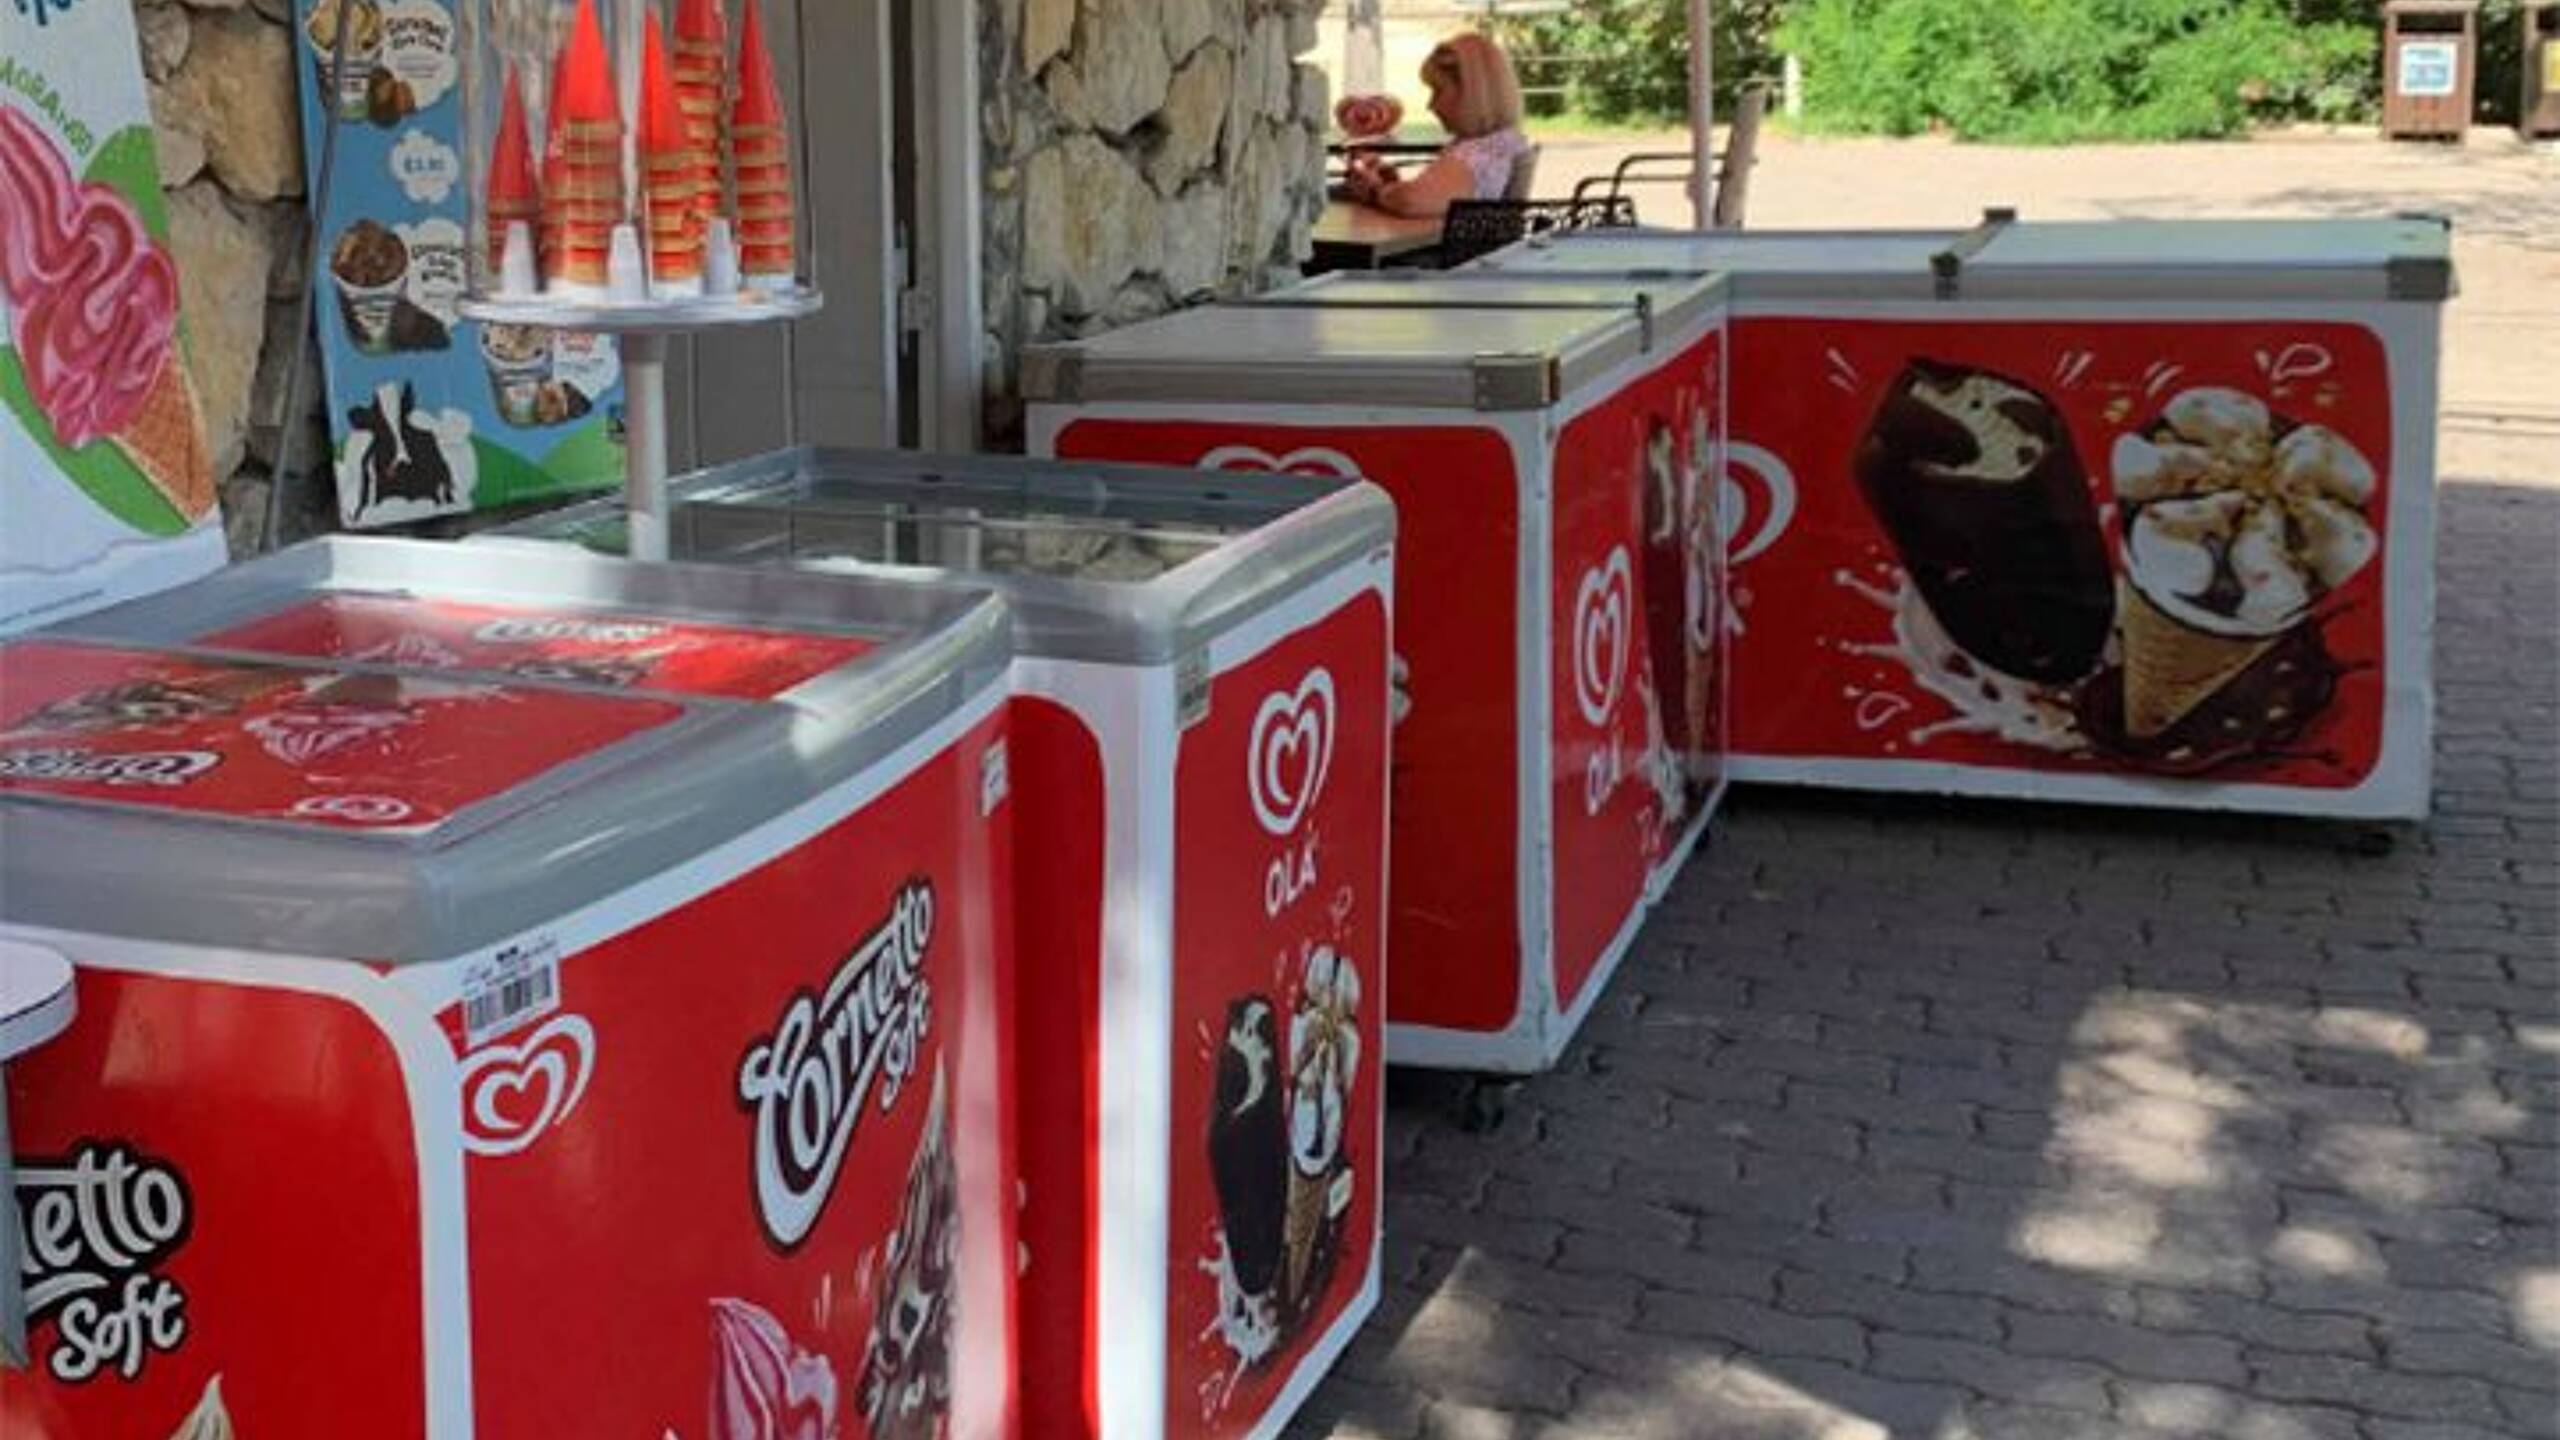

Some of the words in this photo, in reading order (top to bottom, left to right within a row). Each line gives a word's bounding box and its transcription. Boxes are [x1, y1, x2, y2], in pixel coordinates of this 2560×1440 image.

[1265, 820, 1318, 916] OLÁ
[740, 885, 932, 1243] Cornetto
[881, 980, 930, 1110] Soft
[17, 1148, 183, 1290] etto
[52, 1274, 184, 1378] Soft
